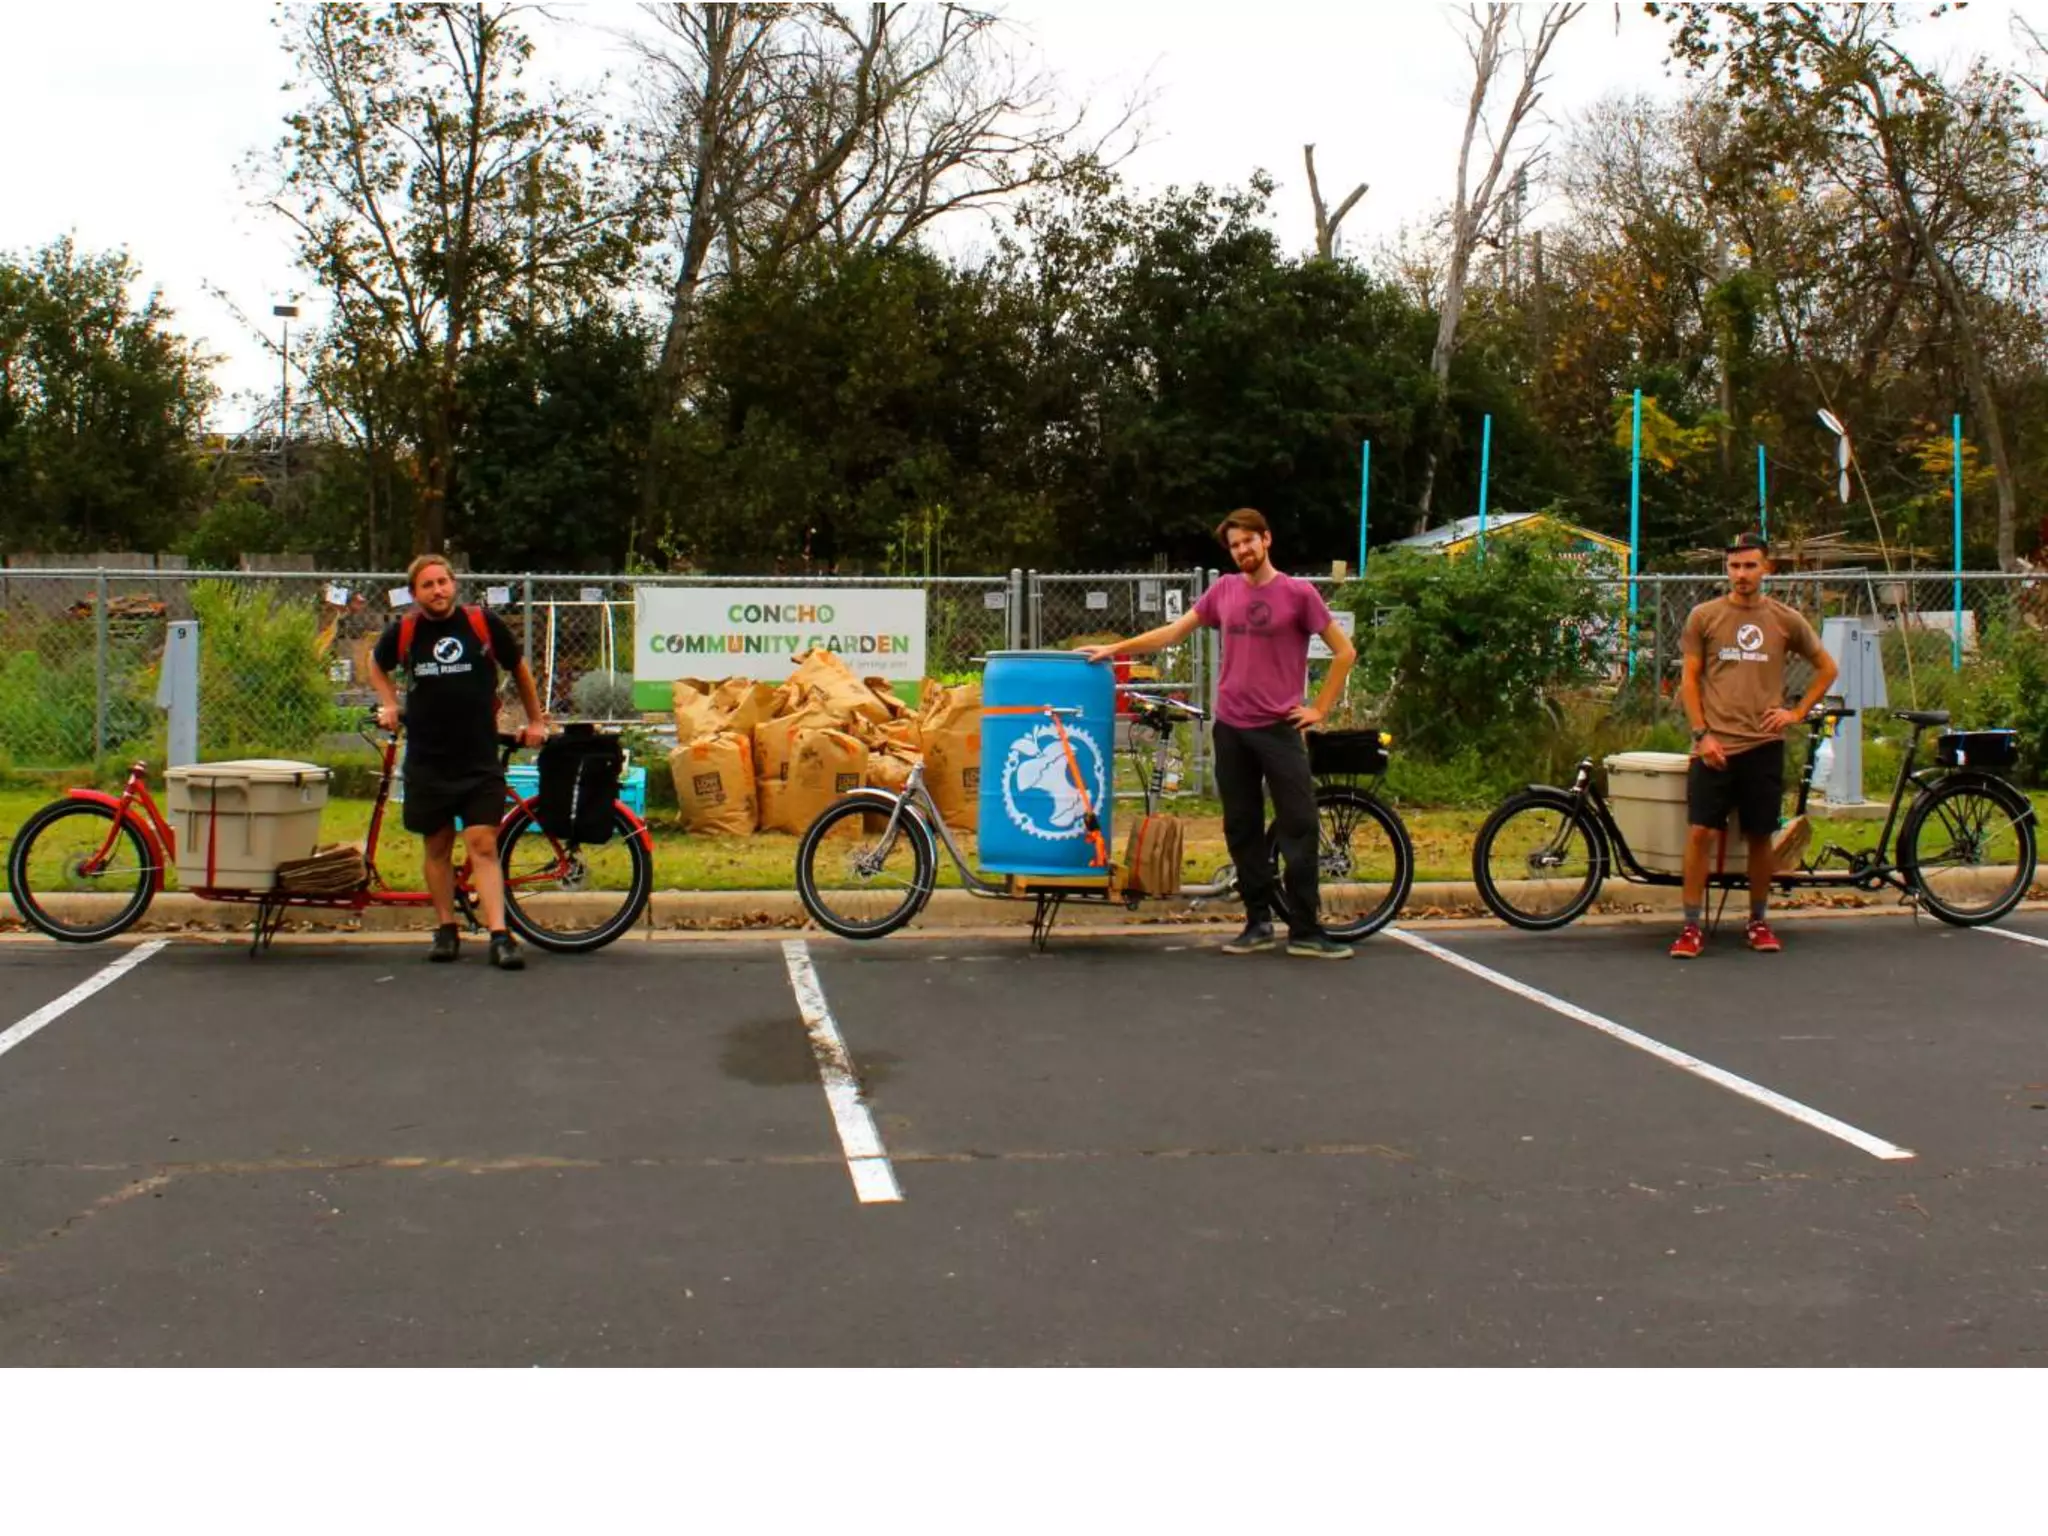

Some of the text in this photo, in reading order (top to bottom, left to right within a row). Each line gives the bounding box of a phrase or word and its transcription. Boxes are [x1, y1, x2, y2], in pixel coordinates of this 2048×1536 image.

[728, 604, 834, 623] CONCHO
[178, 628, 186, 639] 9
[649, 635, 910, 654] COMMUNITY GARDEN
